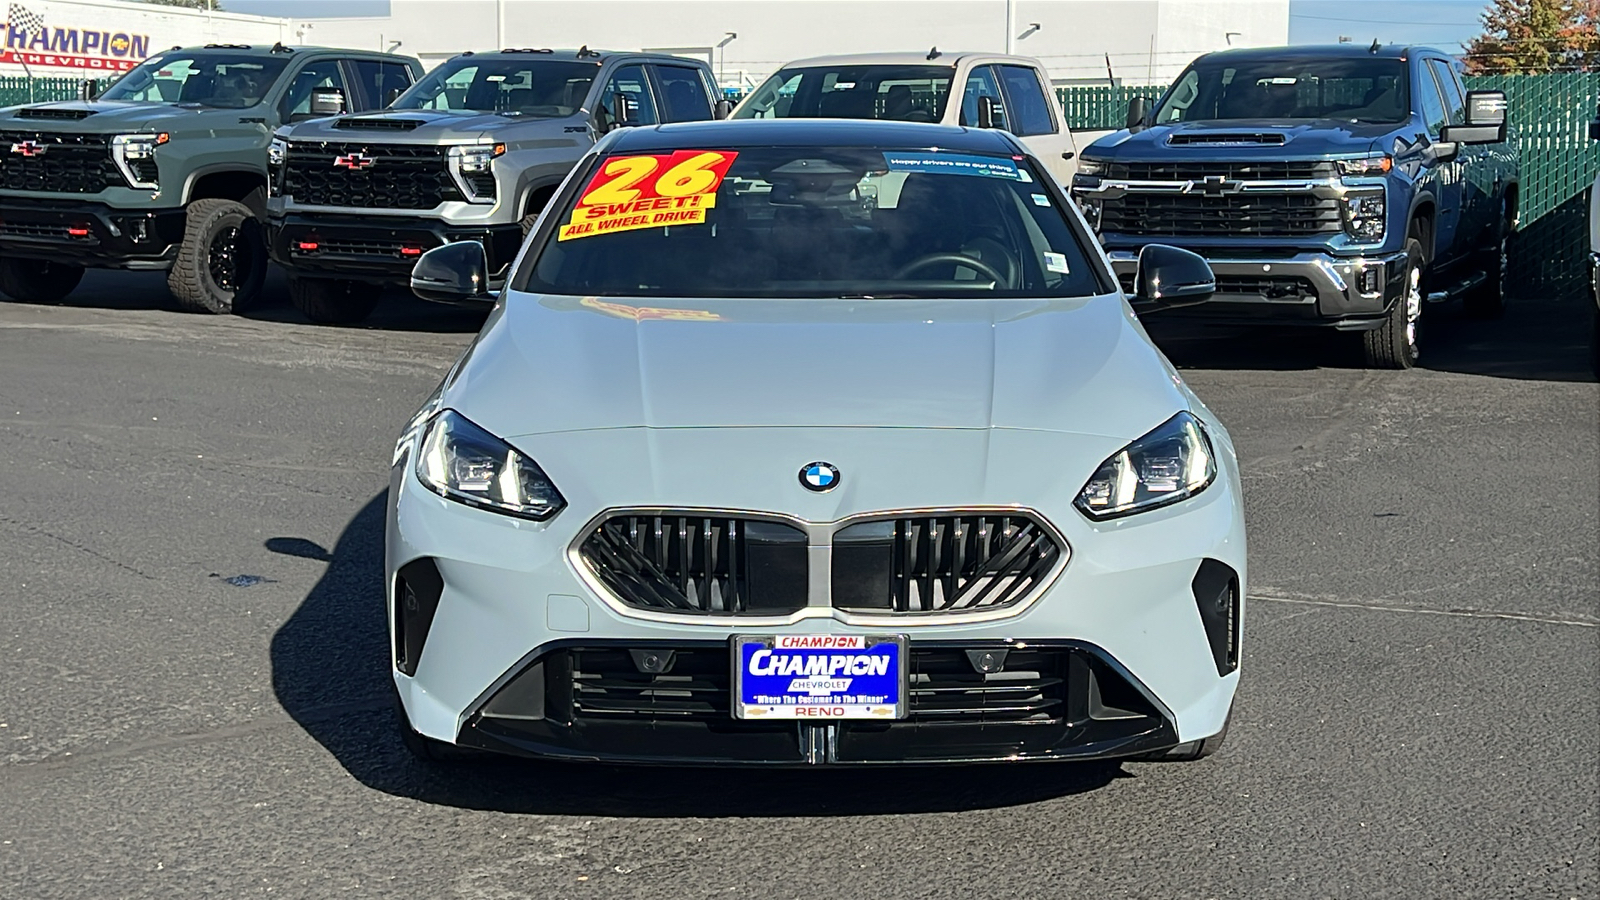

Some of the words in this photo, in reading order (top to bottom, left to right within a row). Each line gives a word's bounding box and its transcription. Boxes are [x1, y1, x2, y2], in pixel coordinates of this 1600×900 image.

[0, 23, 150, 58] HAMPION
[13, 54, 140, 70] CHEVROLE
[890, 158, 921, 166] Happy
[582, 152, 726, 205] 26
[585, 195, 702, 219] SWEET!
[564, 223, 594, 236] ALL
[598, 215, 649, 231] WHEEL
[653, 210, 701, 223] DRIVE
[782, 637, 858, 648] CHAMPION
[748, 649, 891, 676] CHAMPION
[792, 681, 847, 689] CHEVROLET
[782, 695, 797, 704] The
[798, 695, 833, 704] Customer
[834, 695, 842, 704] Is
[843, 695, 856, 704] The
[795, 707, 845, 717] RENO
